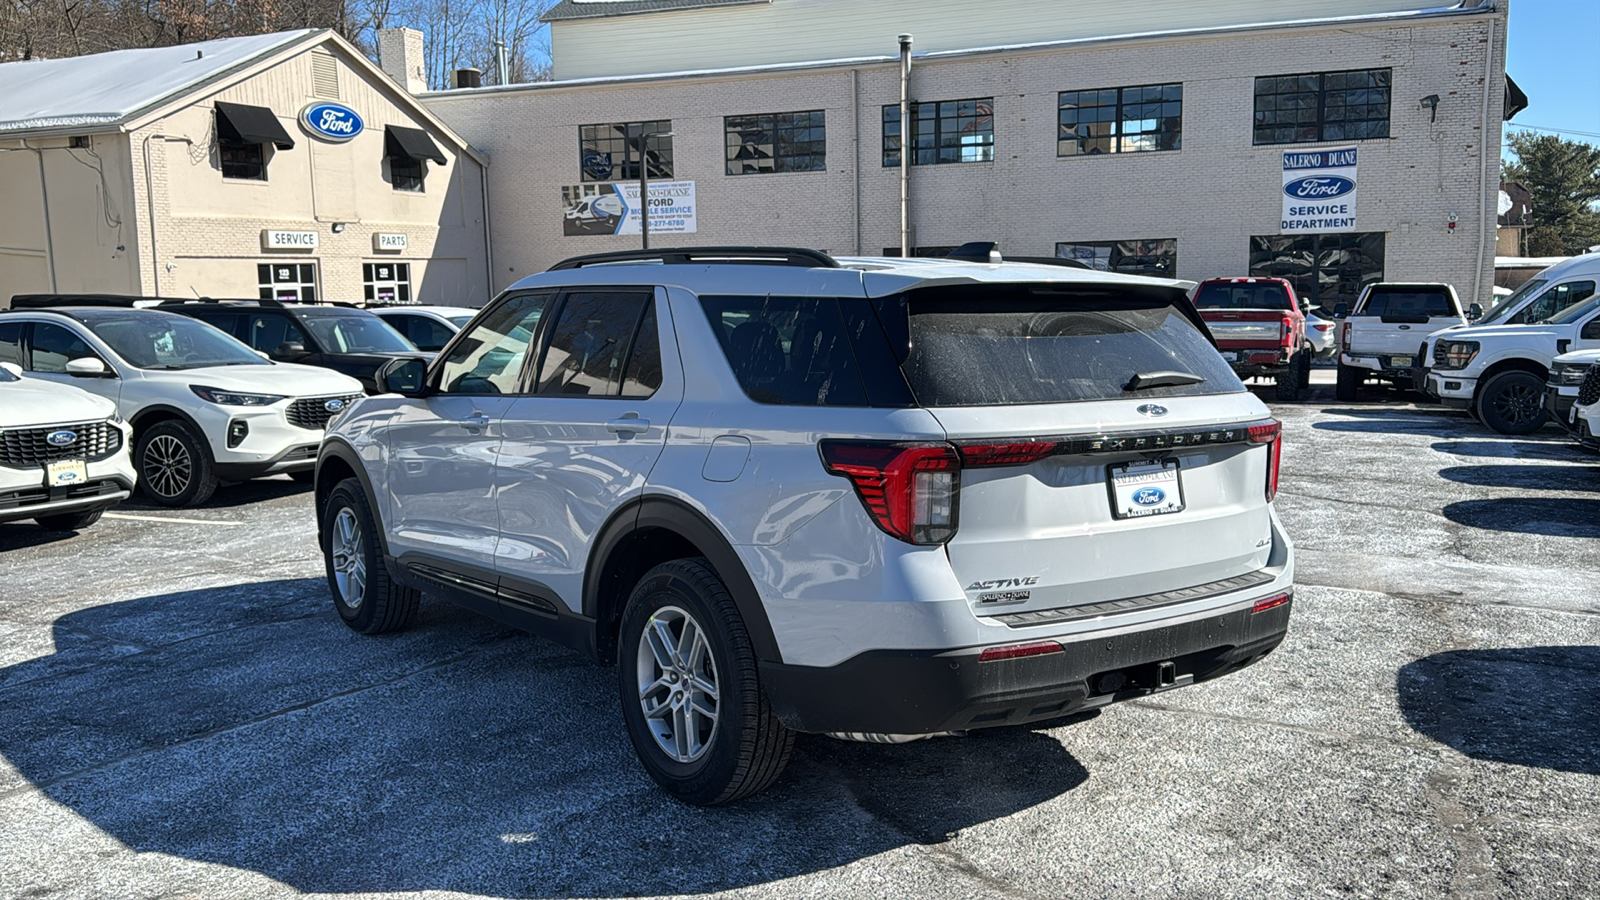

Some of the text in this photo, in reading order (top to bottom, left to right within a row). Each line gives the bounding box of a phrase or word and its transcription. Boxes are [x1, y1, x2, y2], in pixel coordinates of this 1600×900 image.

[319, 109, 354, 133] Ford
[1284, 151, 1356, 168] SALERNO DUANE
[664, 188, 690, 196] DUANE
[1297, 178, 1342, 196] Ford
[647, 197, 674, 207] FORD
[660, 206, 692, 214] SERVICE
[1289, 205, 1348, 216] SERVICE
[1281, 218, 1355, 229] DEPARTMENT
[275, 233, 314, 245] SERVICE
[381, 236, 406, 246] PARTS
[1091, 431, 1234, 450] EXPLORER
[1115, 470, 1176, 485] SALERNO DUANE
[1138, 490, 1160, 503] Ford
[965, 576, 1040, 591] ACTIVE
